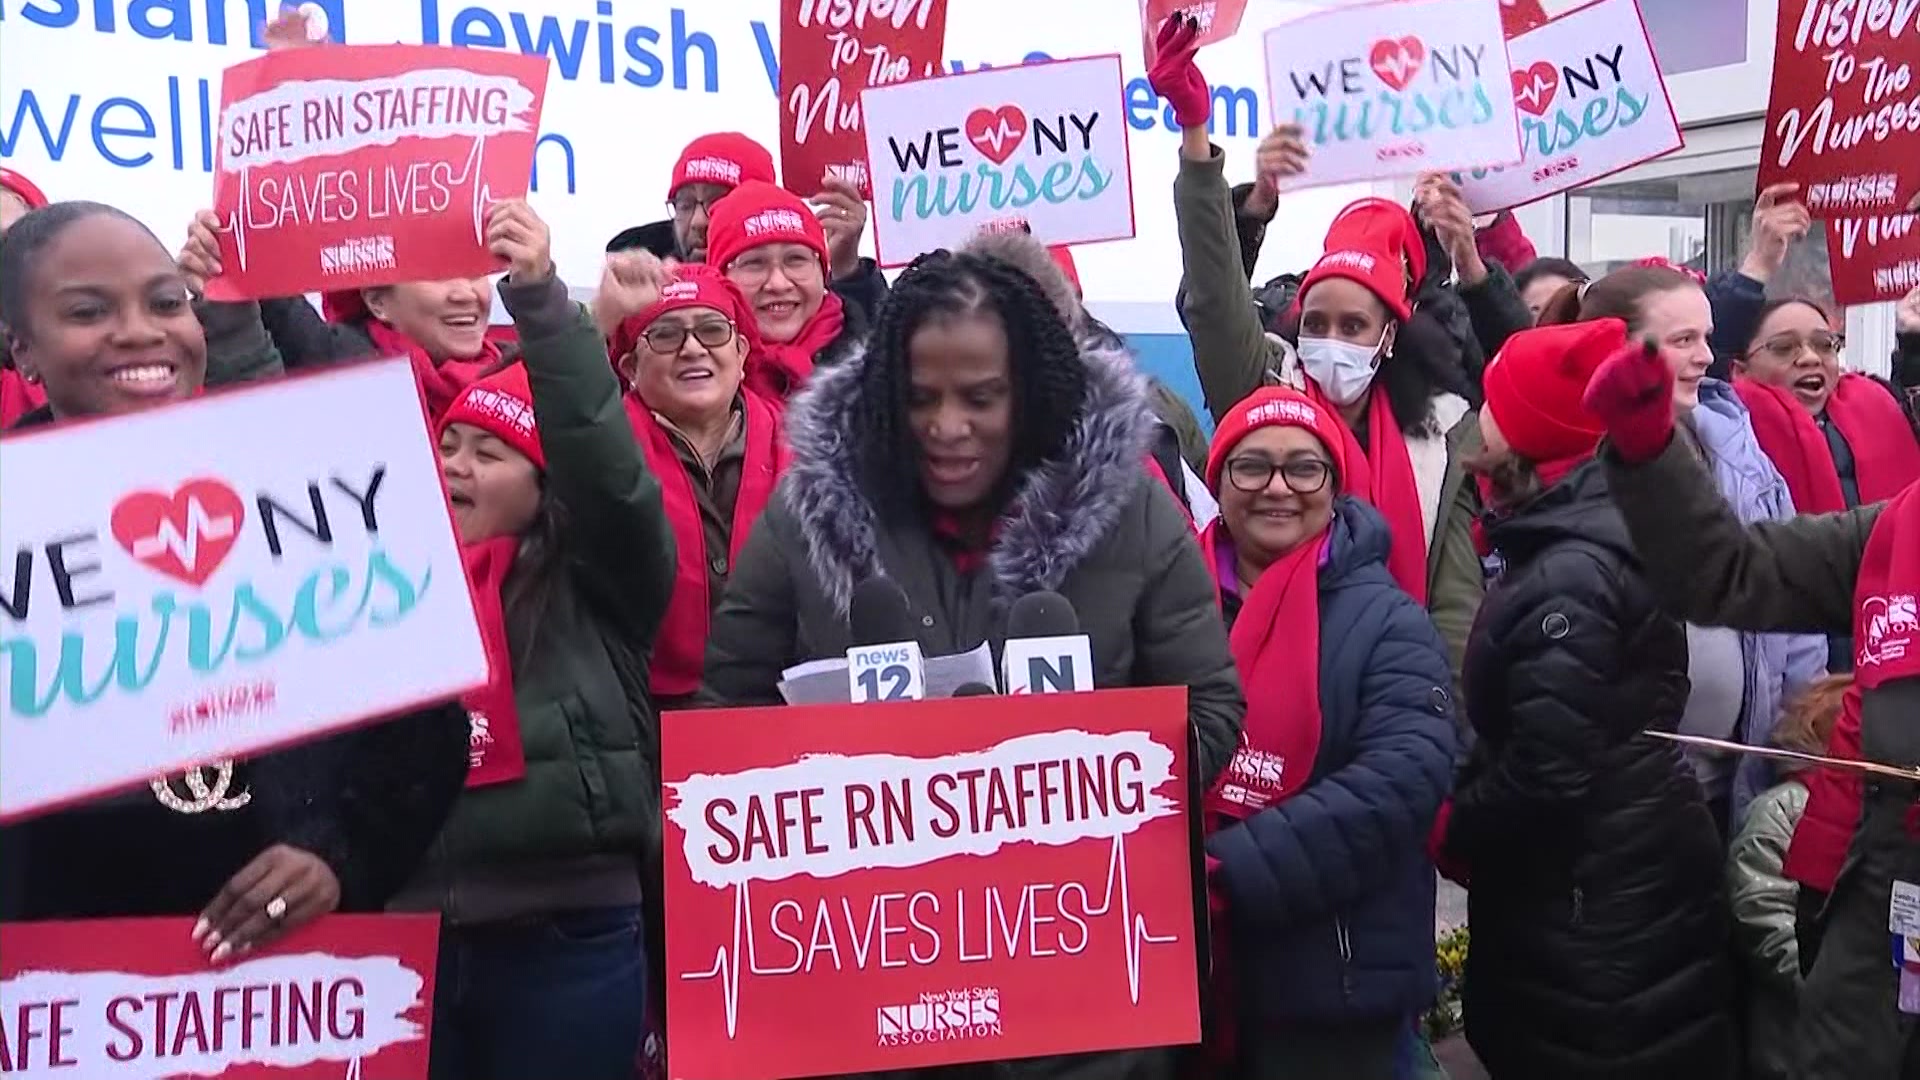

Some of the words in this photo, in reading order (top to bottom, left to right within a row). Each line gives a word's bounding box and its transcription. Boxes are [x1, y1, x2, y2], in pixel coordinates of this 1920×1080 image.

[825, 31, 860, 70] To
[863, 44, 910, 86] The
[1290, 57, 1364, 99] WE
[1431, 43, 1484, 82] NY
[1563, 44, 1623, 98] NY
[1822, 49, 1855, 91] To
[1860, 56, 1911, 104] The
[230, 104, 293, 158] SAFE
[303, 95, 344, 144] RN
[353, 87, 508, 137] STAFFING
[888, 126, 963, 173] WE
[1032, 111, 1099, 157] NY
[258, 170, 358, 230] SAVES
[367, 160, 451, 221] LIVES
[890, 153, 1112, 222] nurses
[256, 461, 387, 558] NY
[857, 648, 910, 666] news
[857, 664, 914, 701] 12
[1028, 655, 1075, 694] N
[704, 786, 830, 865] SAFE
[845, 778, 915, 849] RN
[926, 751, 1146, 840] STAFFING
[769, 889, 941, 974] SAVES
[957, 881, 1087, 963] LIVES
[104, 978, 367, 1062] STAFFING
[877, 998, 1000, 1036] NURSES
[919, 991, 946, 1004] New
[945, 988, 972, 1001] York
[877, 1023, 1004, 1047] ASSOCIATION
